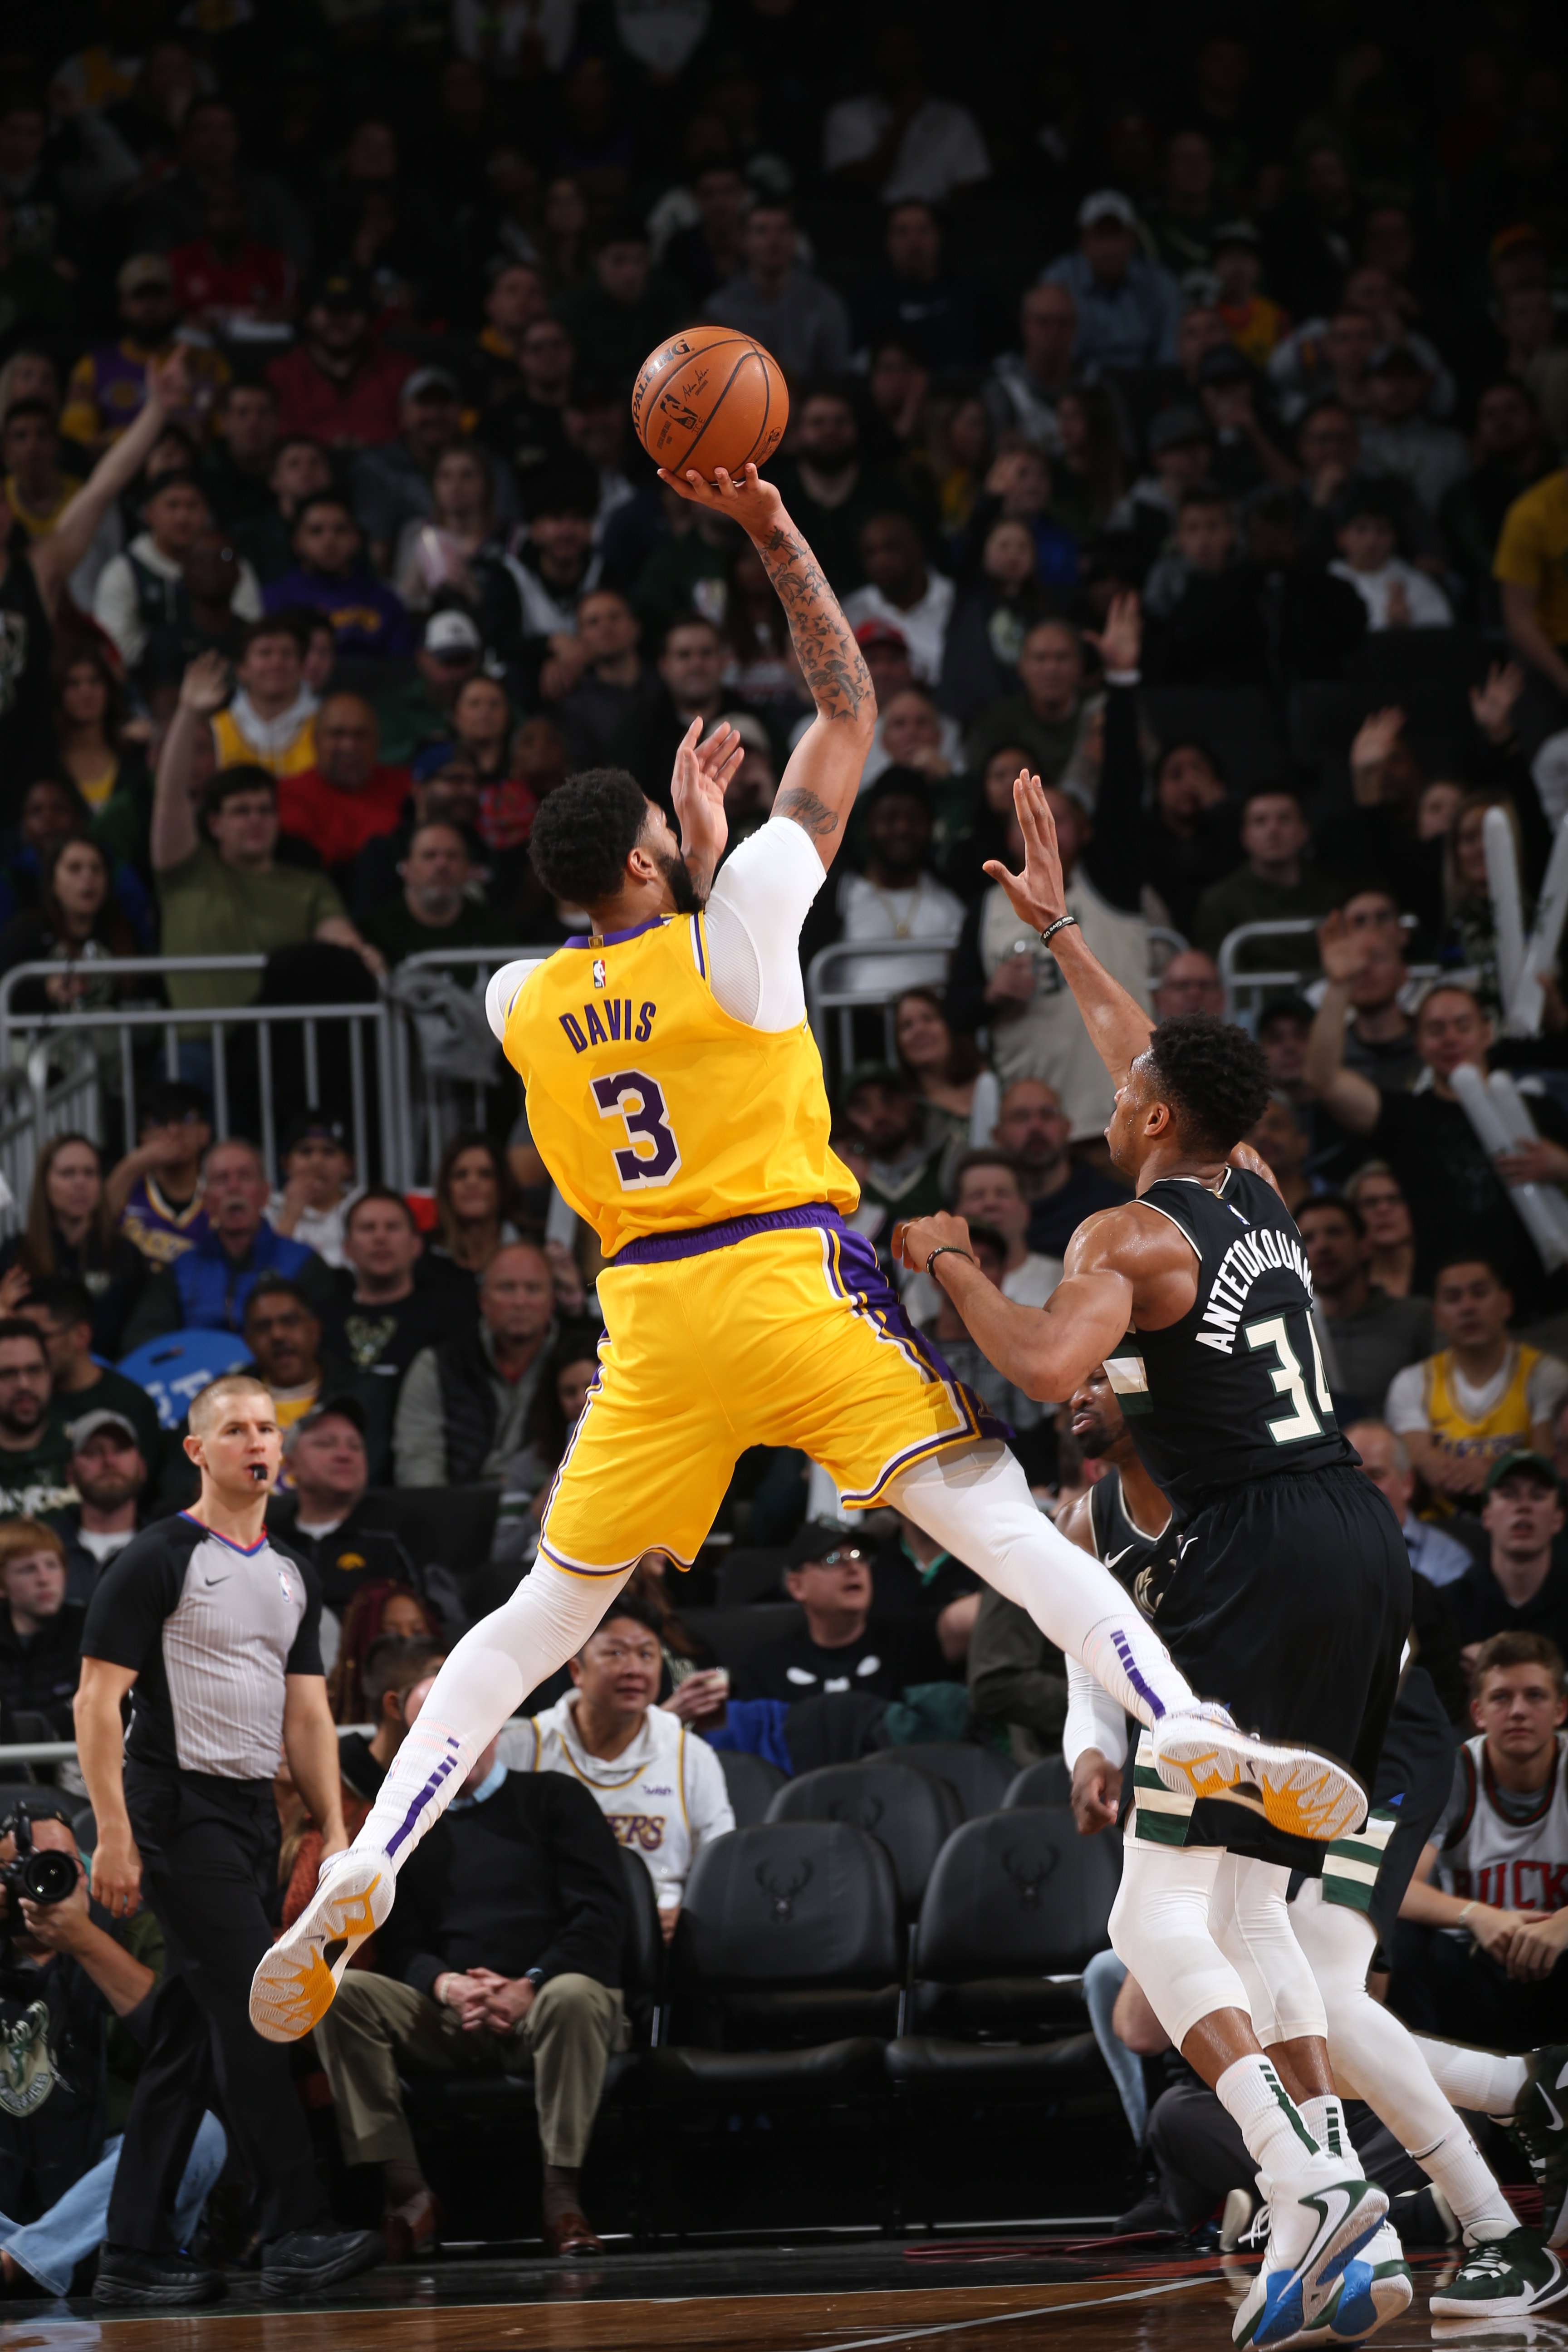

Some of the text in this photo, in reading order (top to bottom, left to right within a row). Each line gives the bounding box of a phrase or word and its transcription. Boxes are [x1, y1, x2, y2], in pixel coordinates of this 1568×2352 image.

[1043, 931, 1050, 939] Up
[1049, 921, 1062, 931] Give
[559, 999, 657, 1054] DAVIS
[588, 1067, 682, 1191] 3
[605, 1813, 668, 1852] ERS
